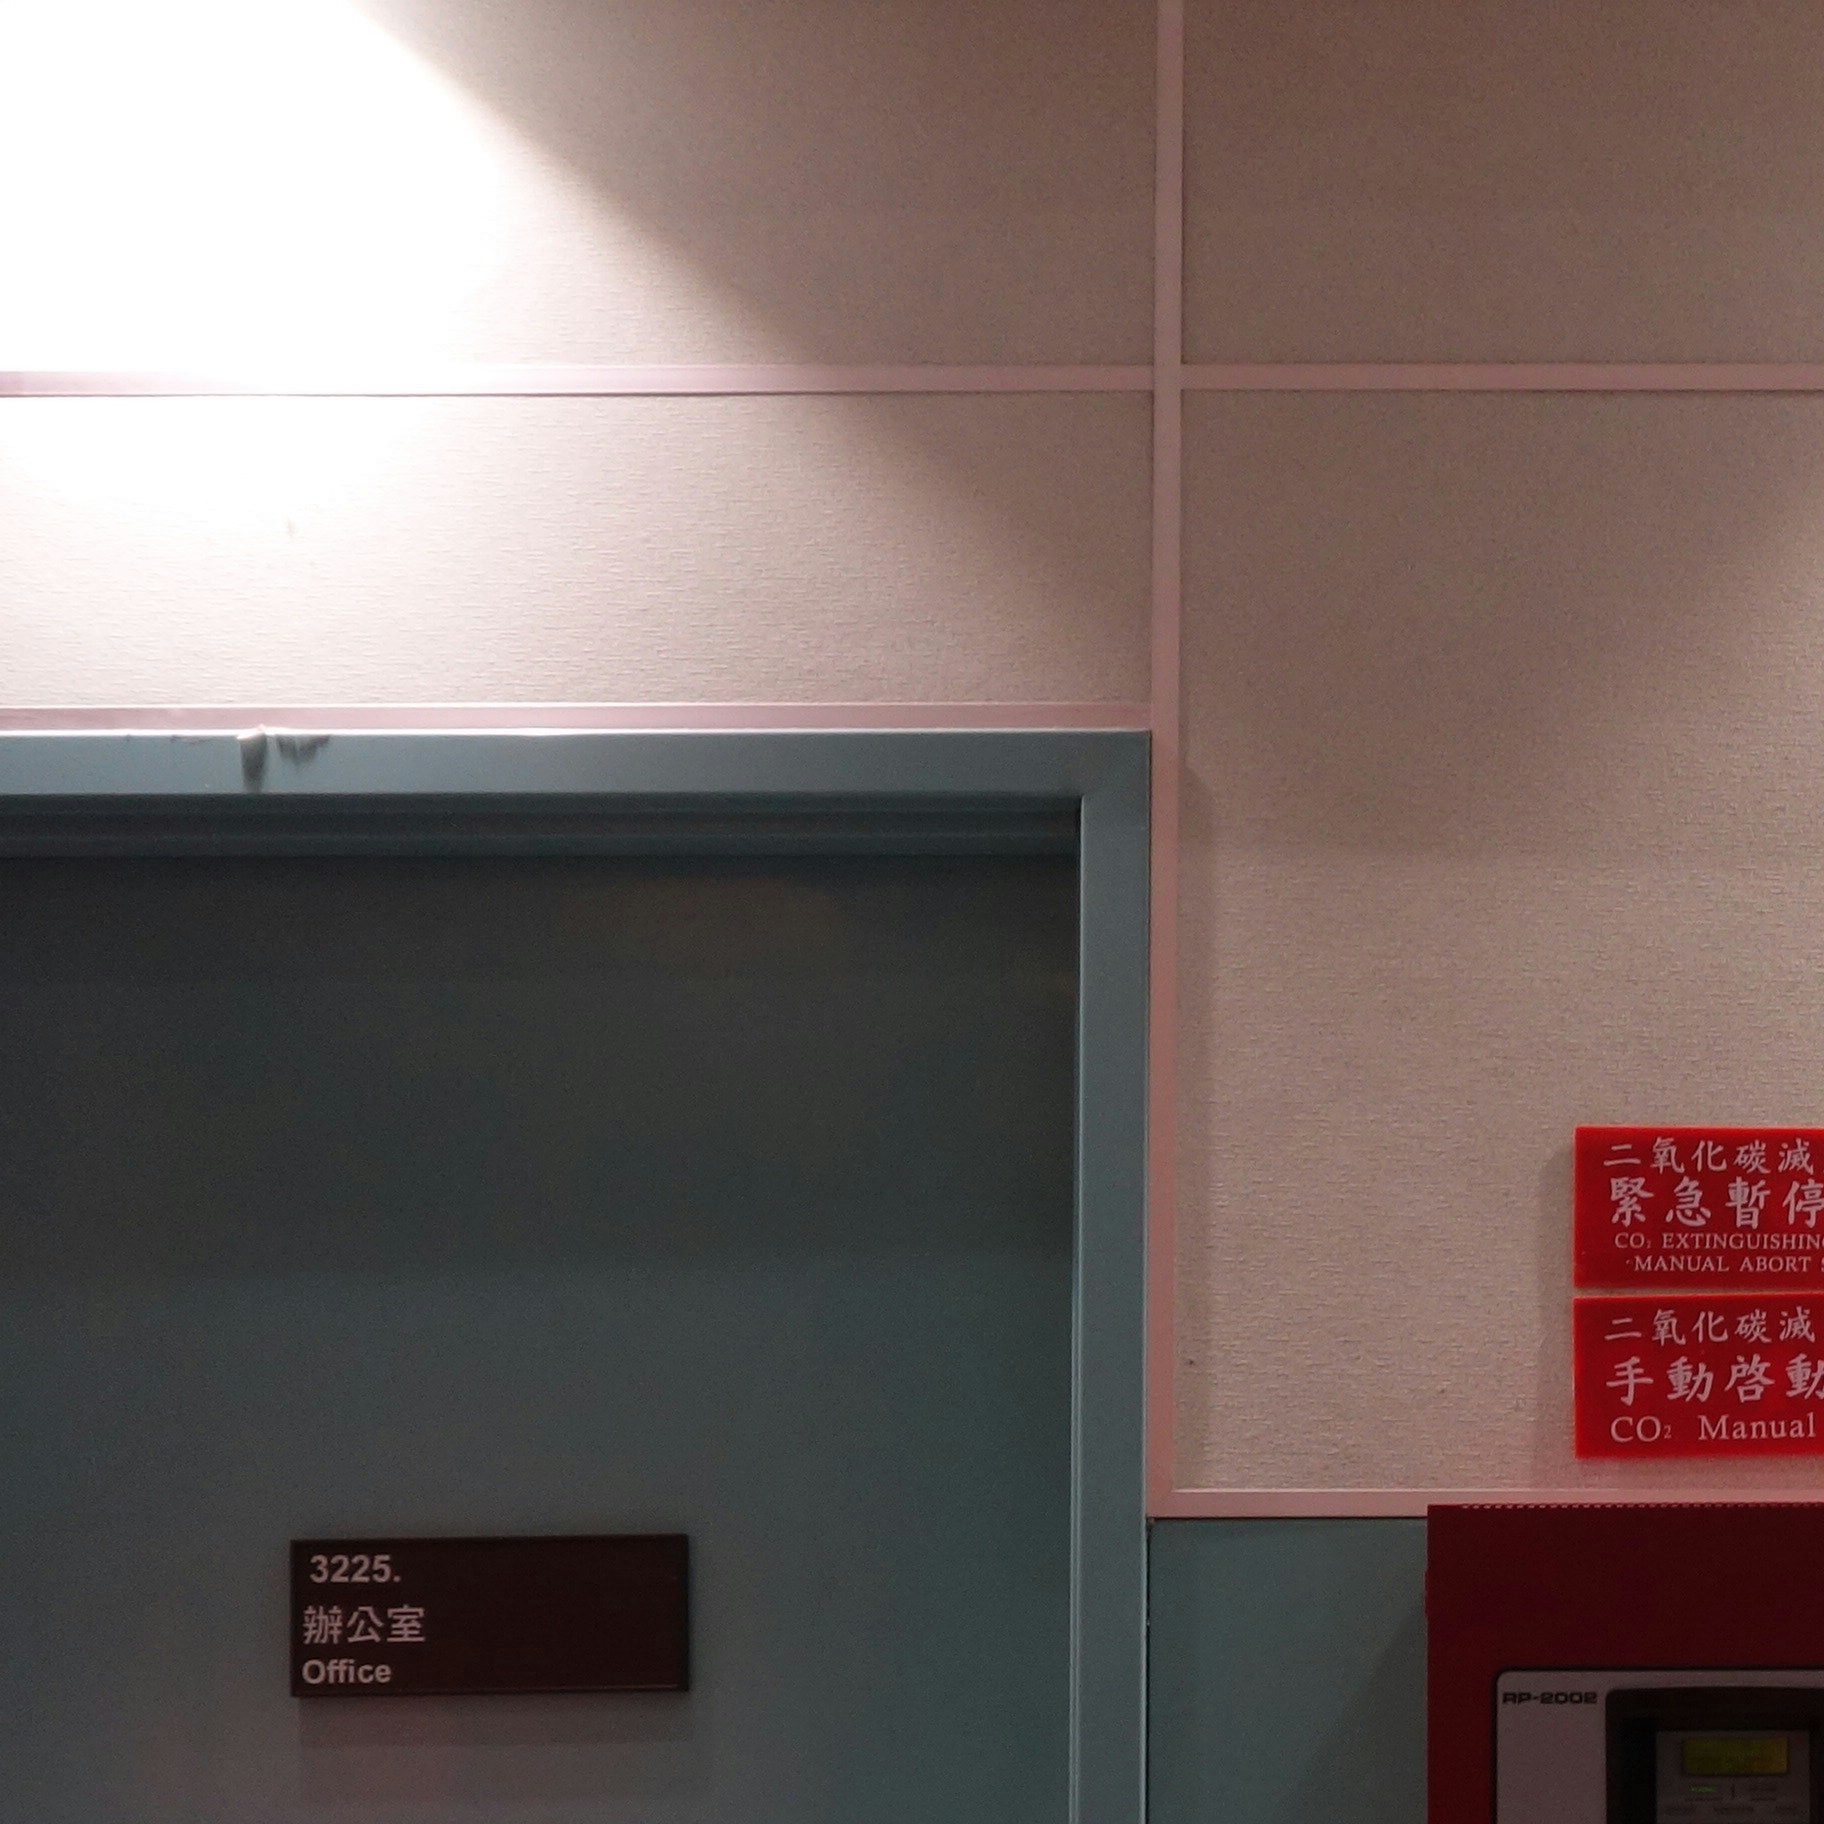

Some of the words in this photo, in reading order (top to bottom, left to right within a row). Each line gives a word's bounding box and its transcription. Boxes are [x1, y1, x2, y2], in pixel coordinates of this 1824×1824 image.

[1633, 1256, 1729, 1273] MANUAL
[1740, 1256, 1811, 1273] ABORT
[1698, 1412, 1817, 1440] Manual
[309, 1554, 401, 1583] 3225.
[302, 1604, 426, 1645] 辦公室
[302, 1659, 392, 1684] Office
